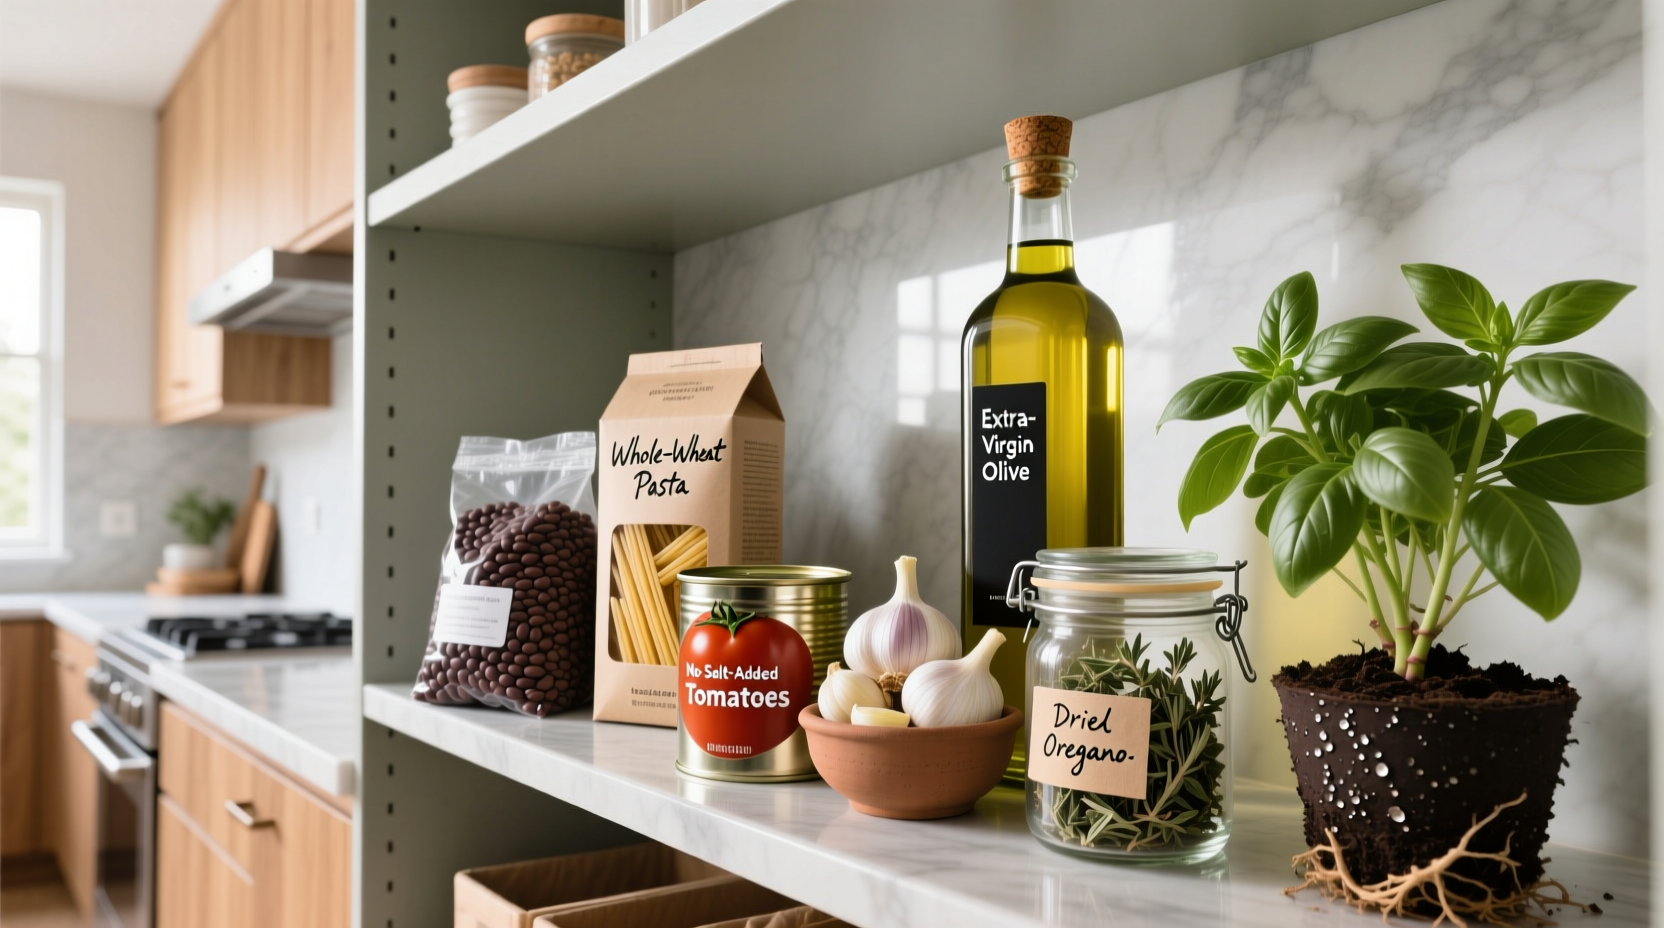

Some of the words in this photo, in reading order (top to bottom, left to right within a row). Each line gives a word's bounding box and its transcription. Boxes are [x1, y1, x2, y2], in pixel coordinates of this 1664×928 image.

[982, 408, 1036, 429] Extra-
[982, 434, 1034, 460] Virgin
[982, 460, 1030, 481] Olive
[633, 470, 690, 500] Pasta
[704, 664, 779, 680] Salt-Added
[685, 682, 790, 708] Tomatoes
